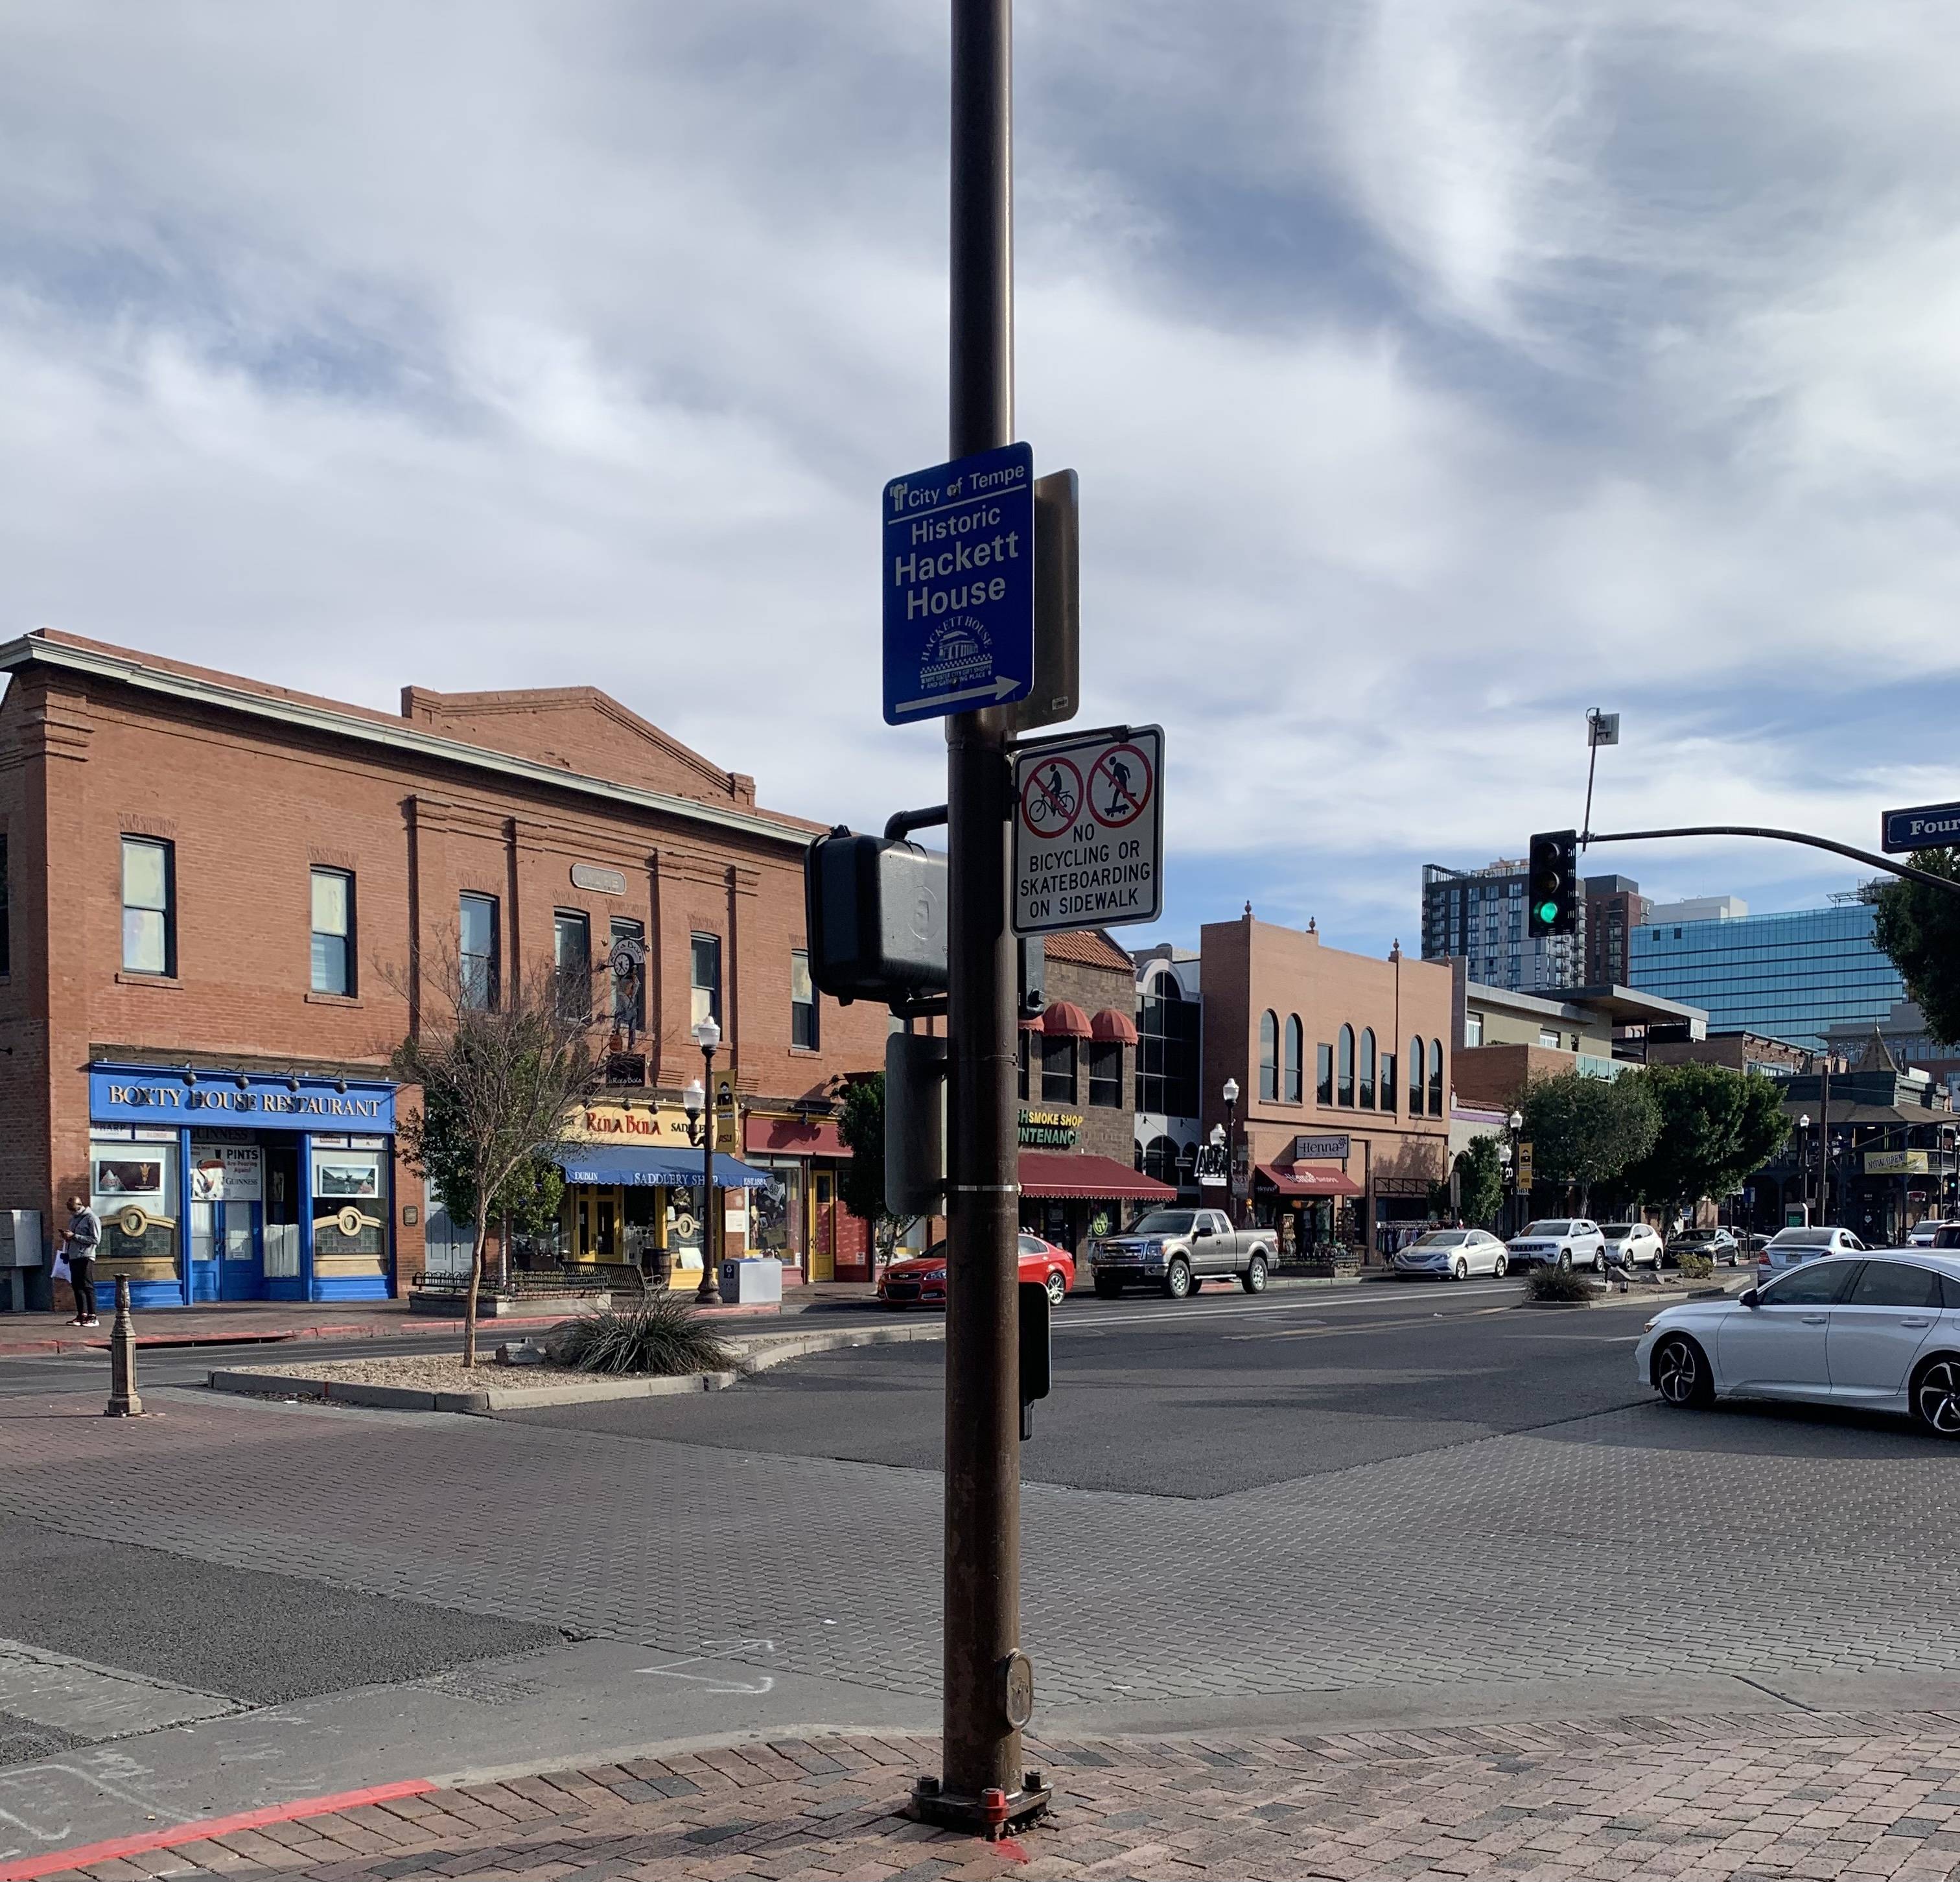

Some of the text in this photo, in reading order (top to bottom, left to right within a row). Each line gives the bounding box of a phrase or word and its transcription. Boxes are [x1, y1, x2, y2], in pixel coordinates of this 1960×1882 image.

[909, 488, 940, 507] City
[946, 477, 962, 497] of
[969, 465, 1025, 490] Tempe
[911, 504, 1001, 545] Historic
[895, 531, 1019, 586] Hackett
[907, 576, 1006, 620] House
[921, 615, 993, 661] HACKETT HOUSE
[969, 672, 986, 680] PLACE
[1073, 823, 1095, 843] NO
[1909, 817, 1960, 835] Four
[1029, 840, 1140, 873] BICYCLING OR
[1020, 862, 1150, 897] SKATEBOARDING
[1030, 888, 1139, 918] ON SIDEWALK
[108, 1085, 381, 1117] BOXTY HOUSE RESTAURANT
[1029, 1111, 1059, 1125] SMOKE
[1060, 1114, 1084, 1127] SHOP
[227, 1149, 259, 1160] PINTS
[1298, 1142, 1340, 1153] Henna
[574, 1171, 598, 1181] DUBLIN
[635, 1172, 688, 1185] SADDLERY
[692, 1175, 718, 1186] SHP
